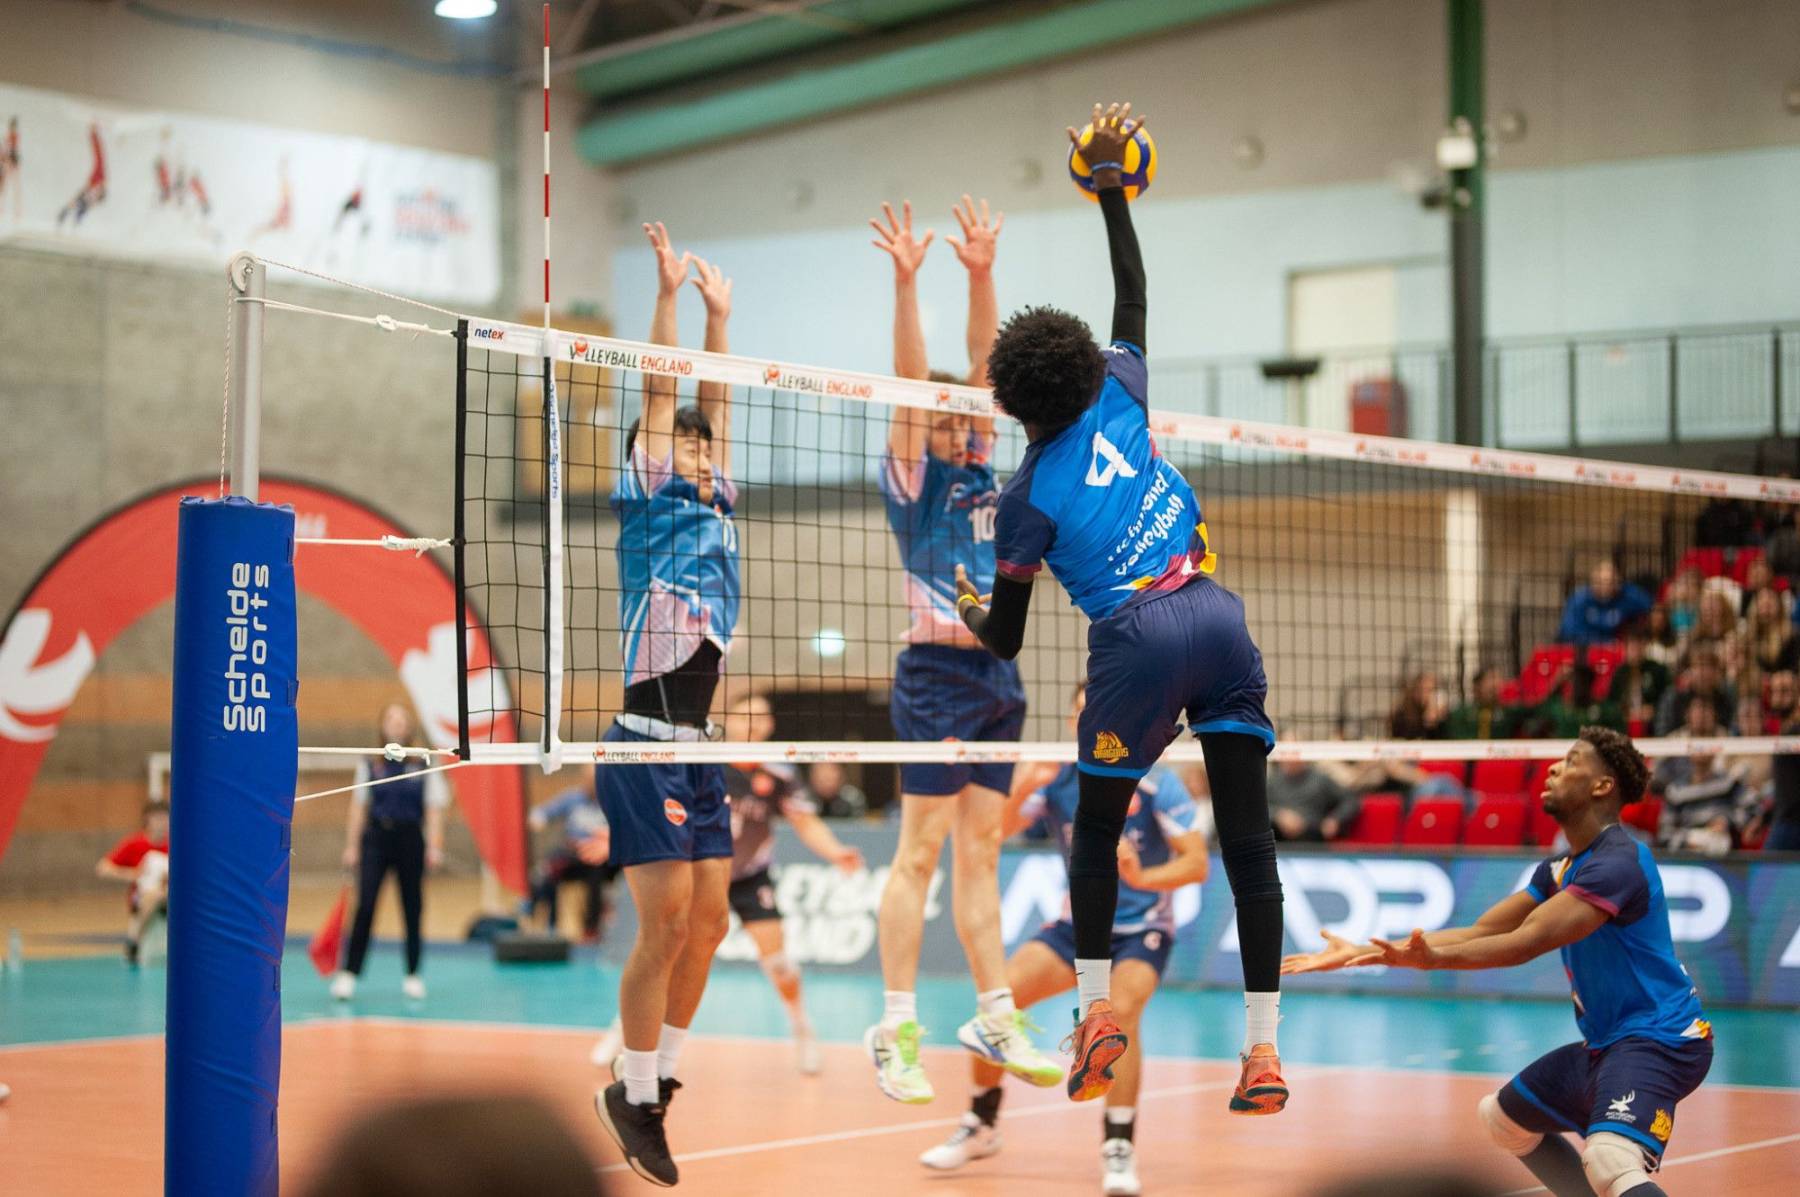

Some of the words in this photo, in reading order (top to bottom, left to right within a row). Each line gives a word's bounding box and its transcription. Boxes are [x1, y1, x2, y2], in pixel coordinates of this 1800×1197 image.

[474, 327, 504, 341] netex
[640, 355, 693, 375] ENGLAND
[1085, 431, 1138, 487] 4
[968, 505, 997, 544] 10
[223, 562, 250, 732] Schelde
[247, 564, 271, 733] Sports
